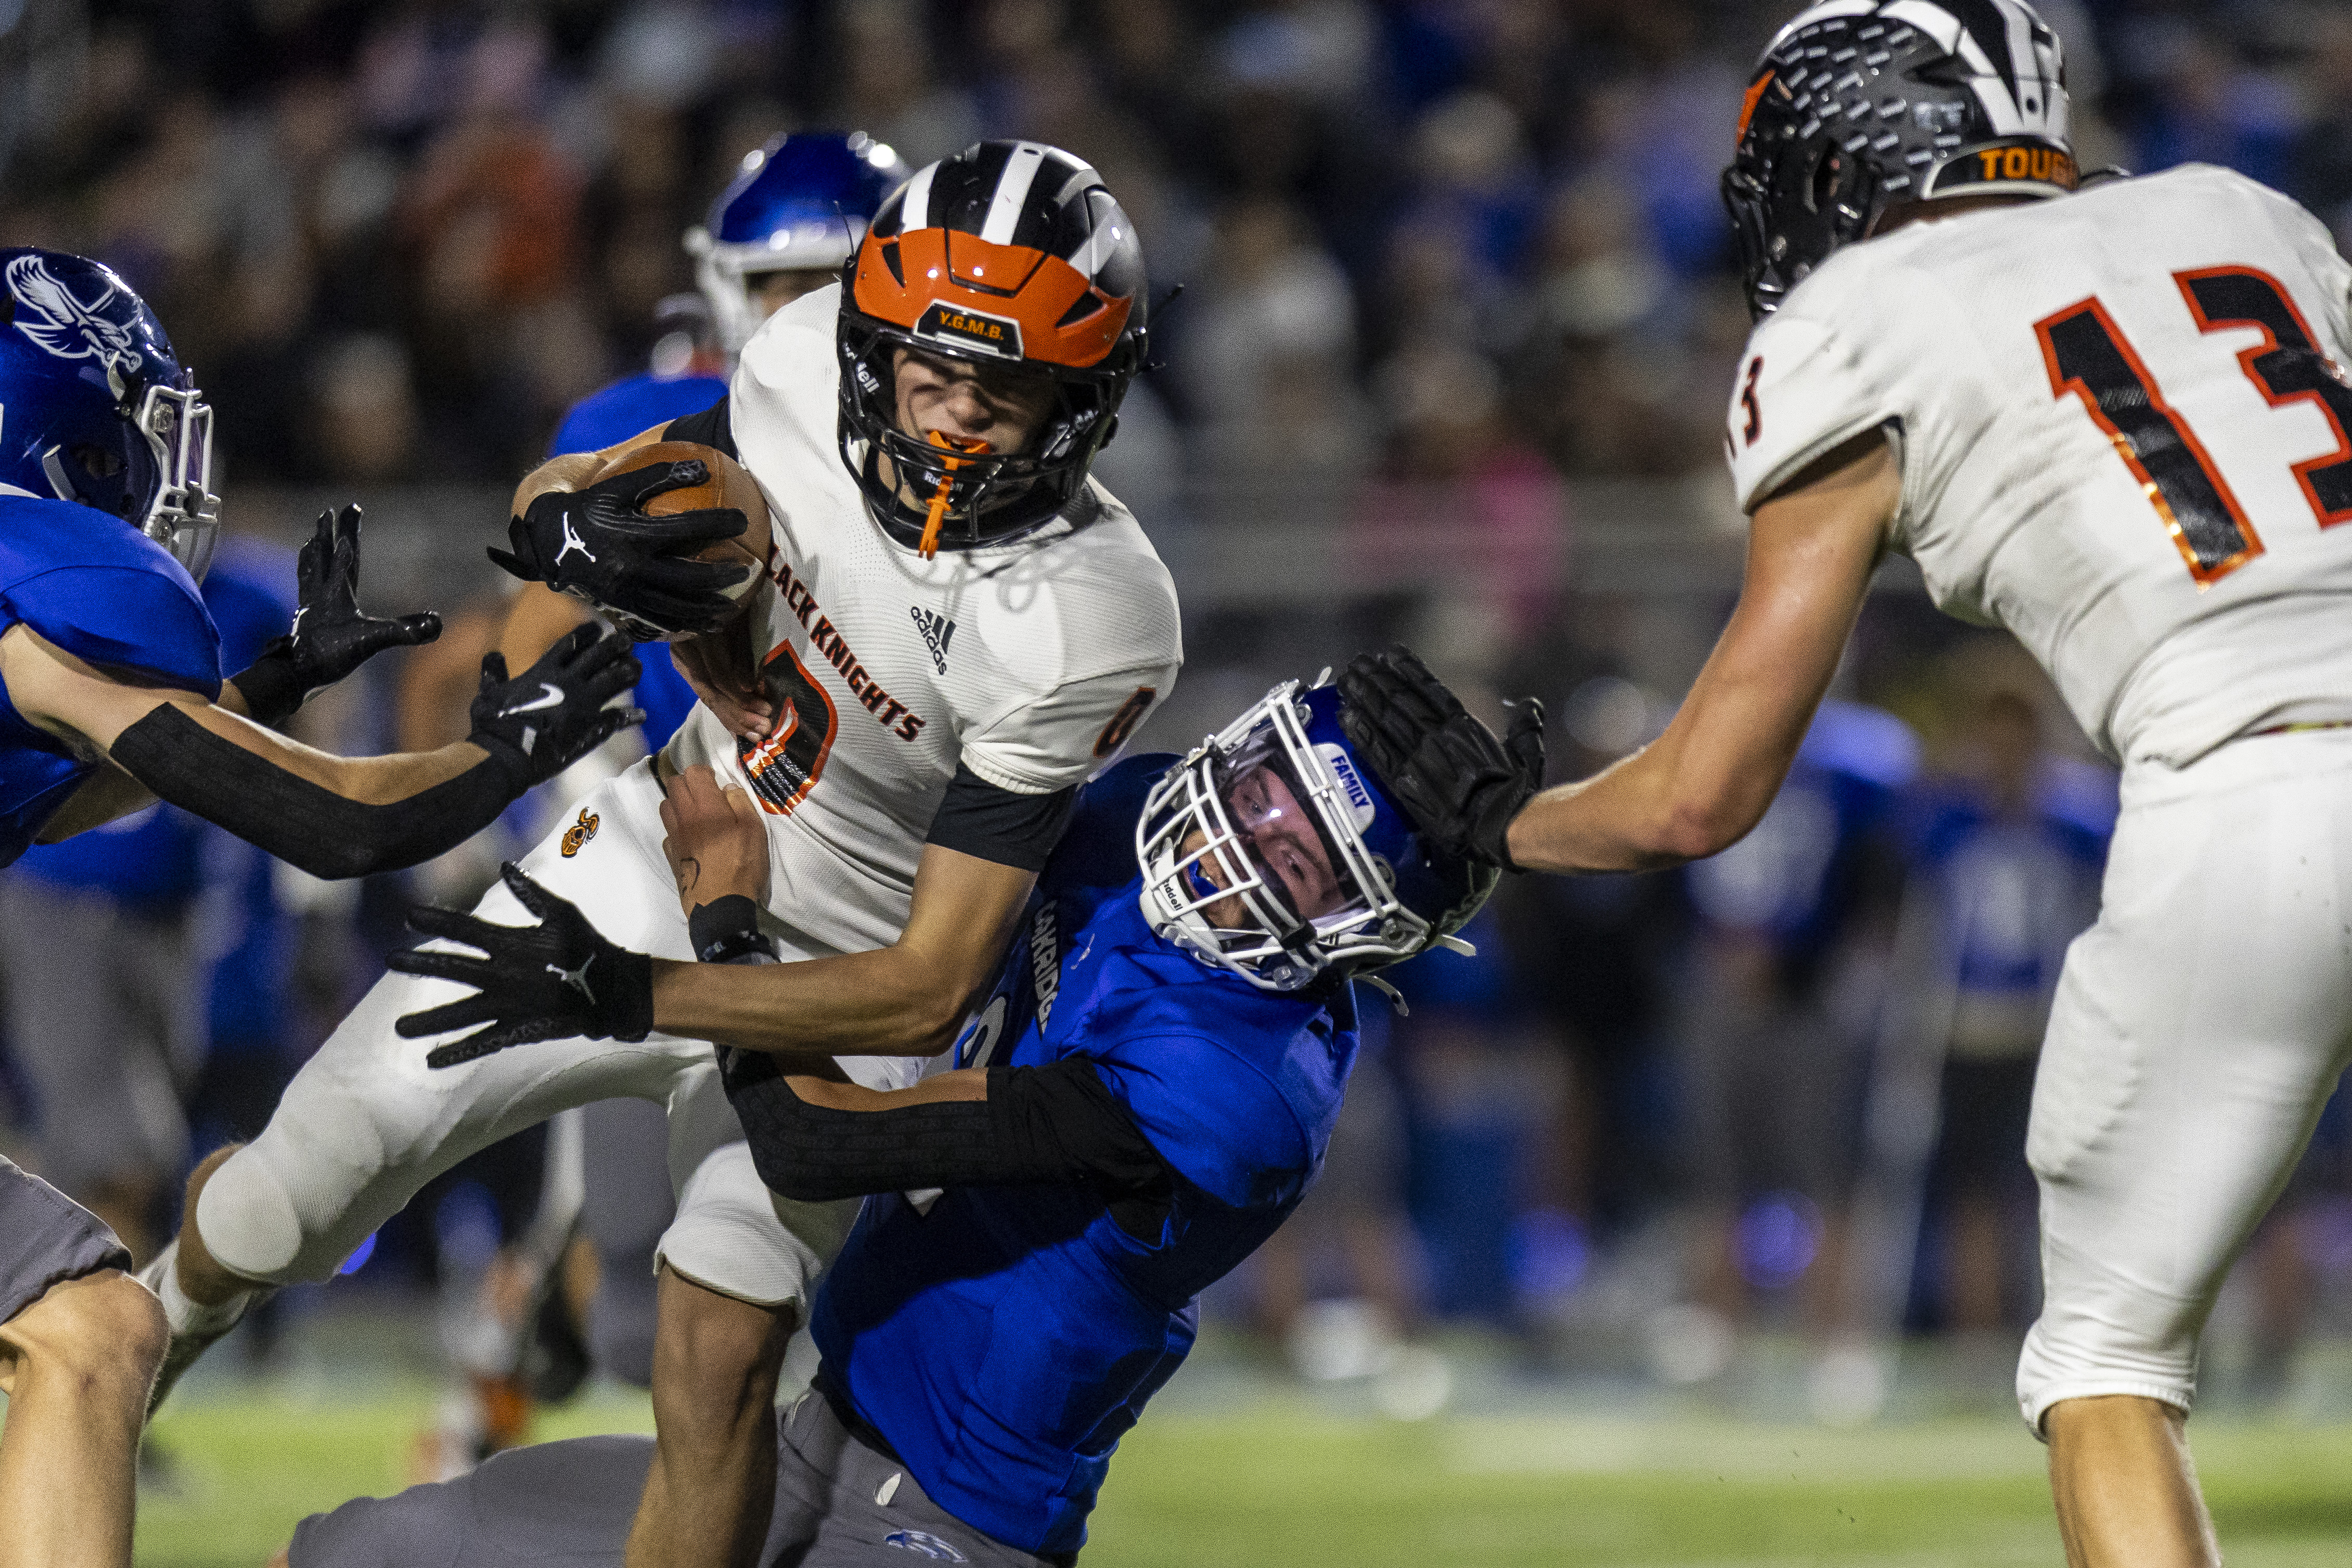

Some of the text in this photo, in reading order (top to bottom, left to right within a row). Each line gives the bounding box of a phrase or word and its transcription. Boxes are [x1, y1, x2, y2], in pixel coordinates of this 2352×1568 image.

[940, 311, 1004, 340] Y.G.M.B.
[2032, 264, 2352, 588] 13
[766, 542, 927, 742] LACK KNIGHTS
[910, 606, 947, 676] adidas
[1330, 755, 1370, 808] FAMILY
[1163, 878, 1184, 911] iddell
